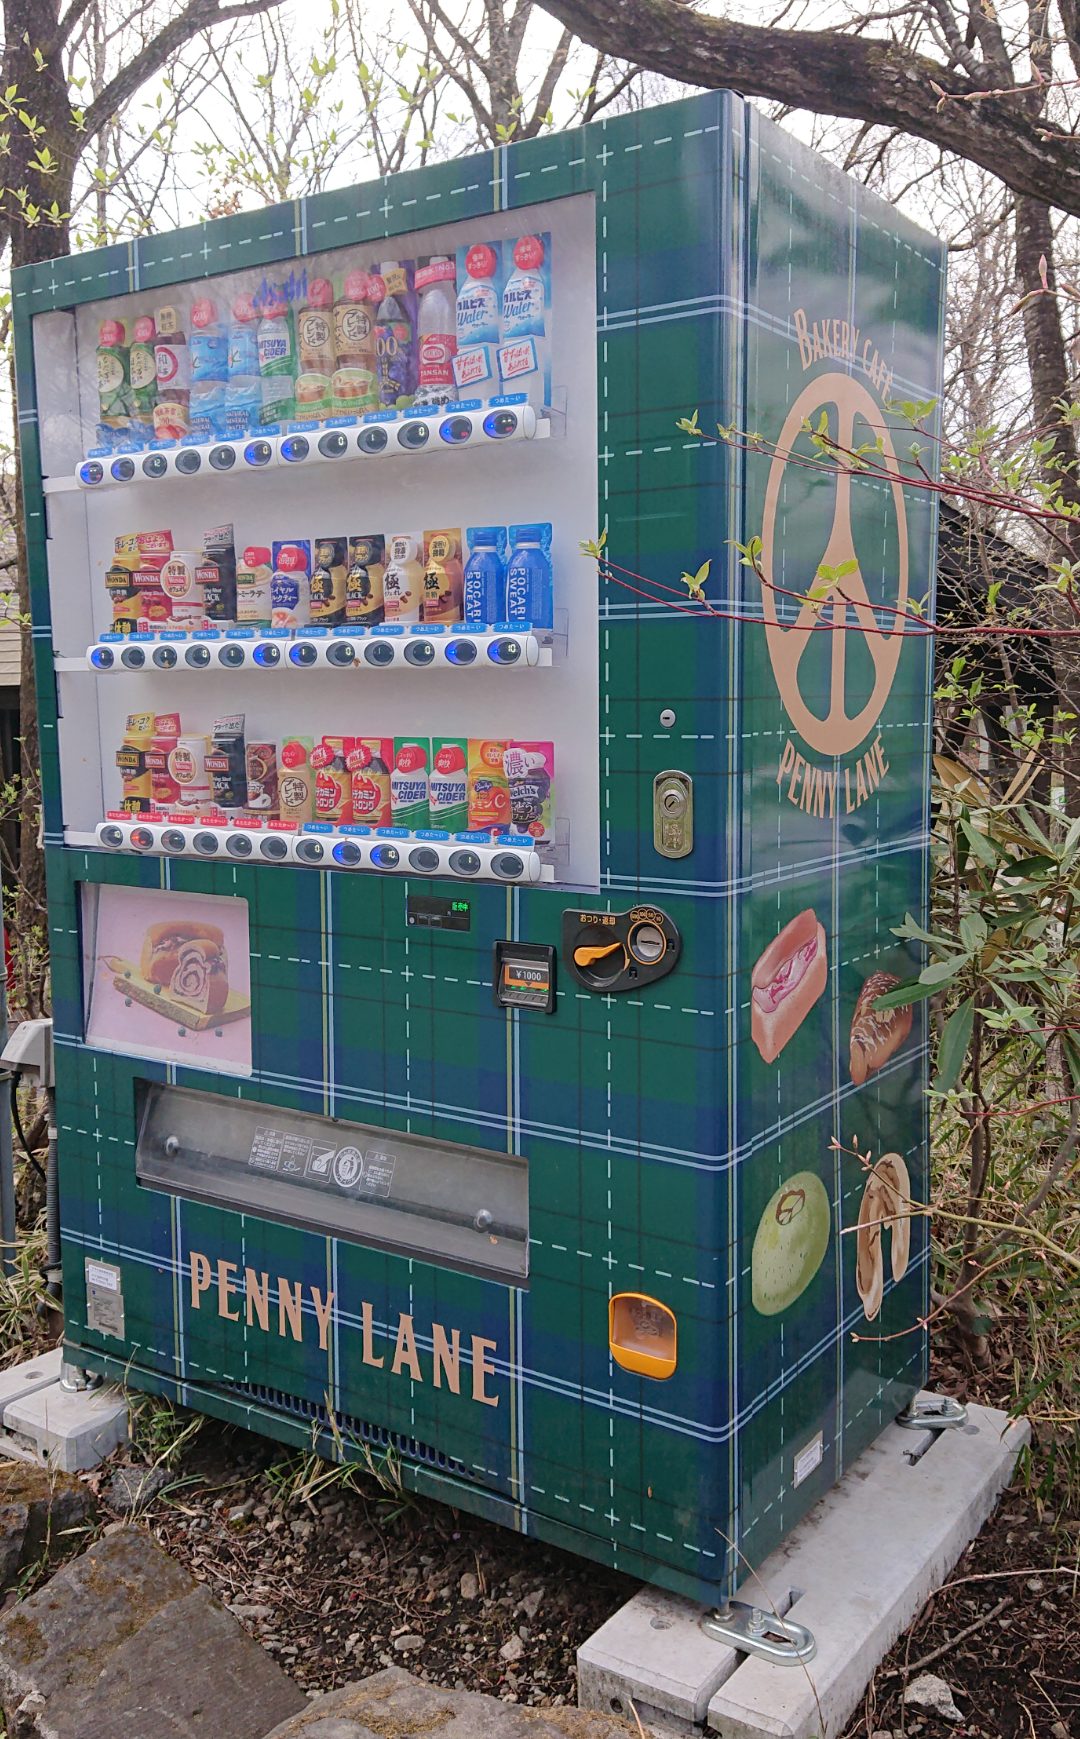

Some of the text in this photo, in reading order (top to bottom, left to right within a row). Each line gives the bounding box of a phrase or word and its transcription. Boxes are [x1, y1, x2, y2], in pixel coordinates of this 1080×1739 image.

[457, 309, 488, 325] Water
[504, 301, 535, 318] Water
[794, 308, 860, 371] BAKERY
[263, 347, 287, 356] CIDER
[134, 574, 160, 583] WONDA
[204, 593, 220, 601] LACK
[473, 571, 481, 622] POCARI
[517, 568, 525, 620] POCARI
[205, 758, 227, 768] WONDA
[505, 751, 535, 776] 濃い
[776, 732, 890, 818] PENNY LANE
[213, 781, 229, 789] LACK
[285, 779, 294, 804] ブレンド
[293, 782, 304, 800] 特製
[398, 791, 426, 799] CIDER
[437, 792, 466, 801] CIDER
[516, 970, 542, 981] ¥1000
[190, 1251, 336, 1350] PENNY
[361, 1301, 499, 1407] LANE
